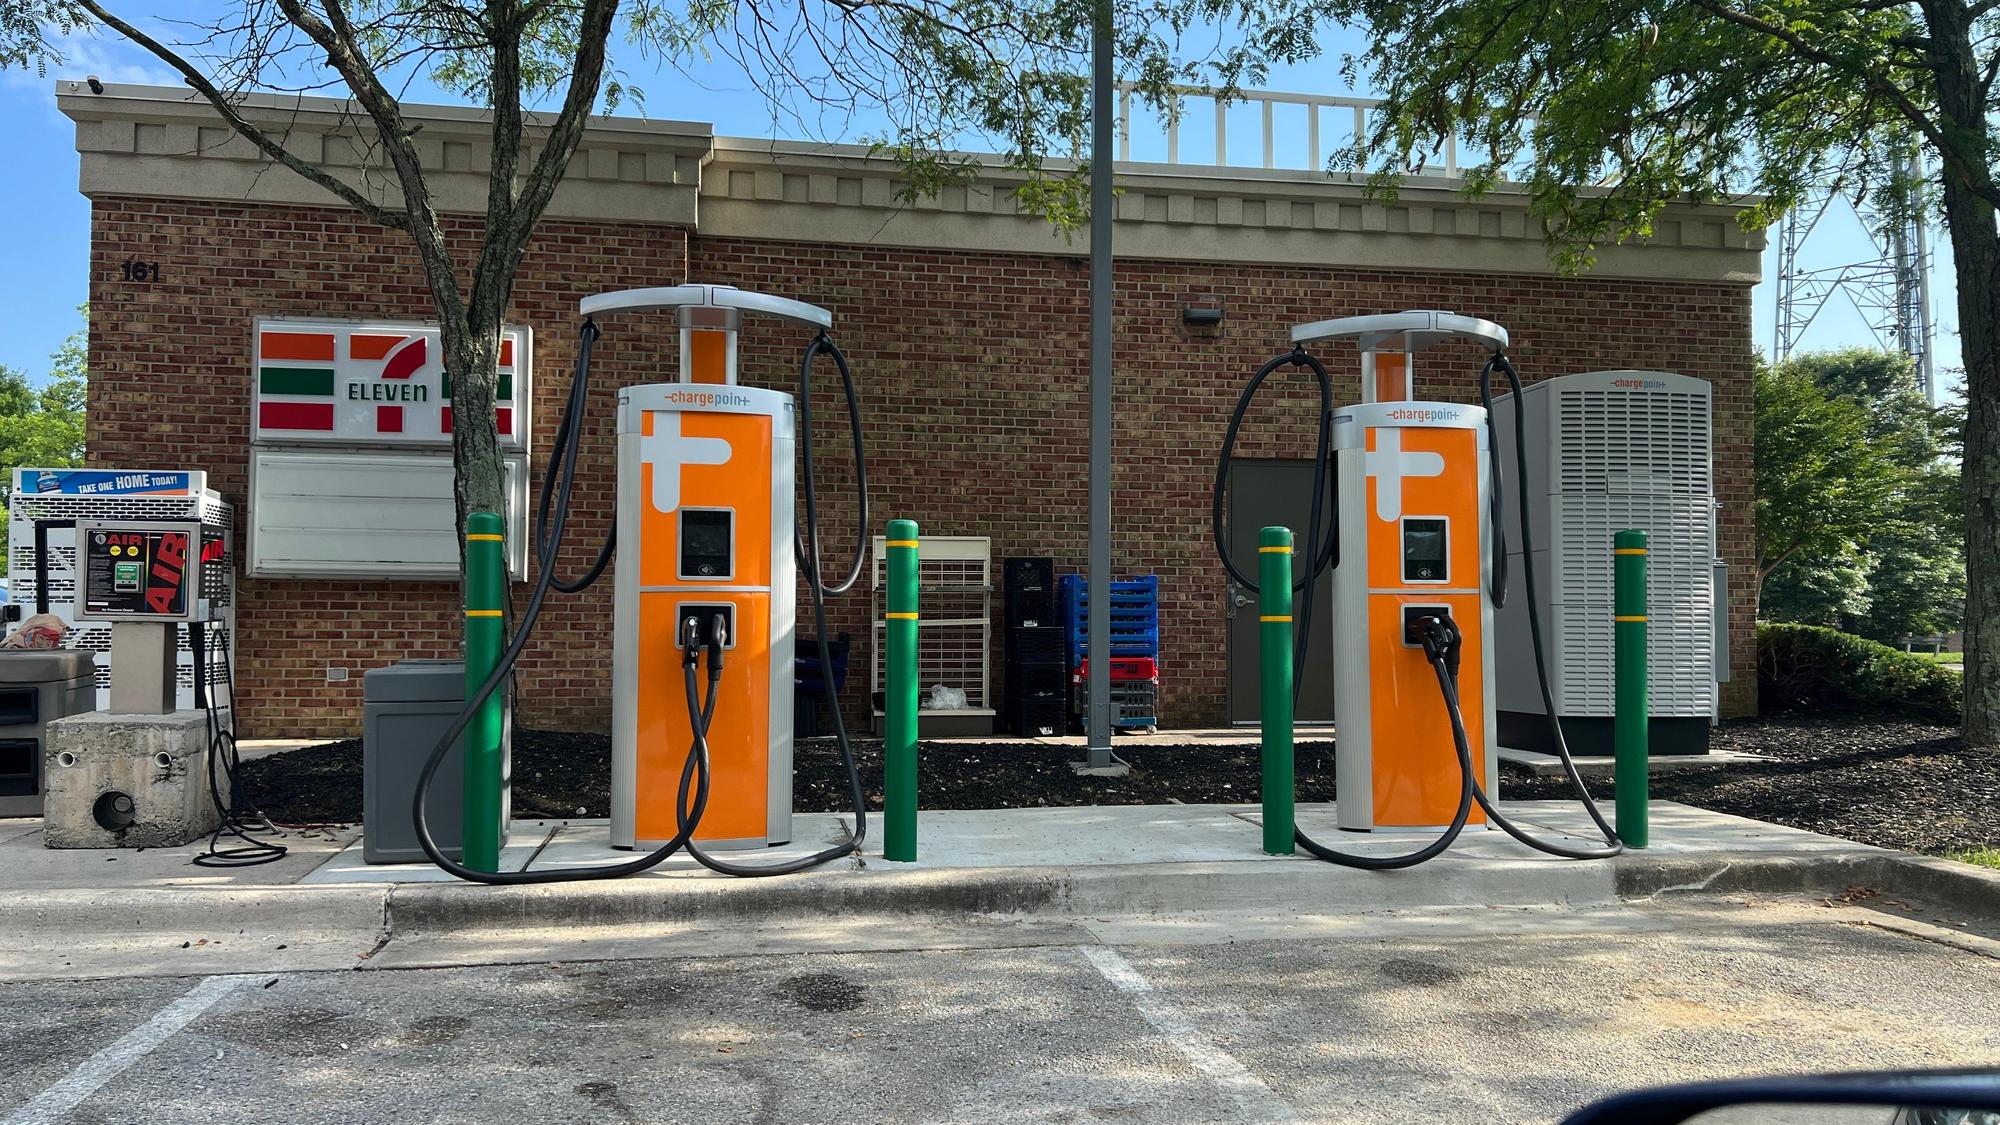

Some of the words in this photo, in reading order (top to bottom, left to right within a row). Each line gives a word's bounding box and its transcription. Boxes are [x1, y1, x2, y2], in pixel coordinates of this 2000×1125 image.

[121, 261, 158, 283] 161
[350, 333, 427, 433] 7
[78, 484, 97, 494] TAKE
[98, 481, 114, 492] ONE
[115, 474, 150, 490] HOME
[151, 475, 178, 487] TODAY!
[107, 534, 143, 545] AIR
[201, 539, 225, 565] AIR
[146, 531, 187, 613] AIR
